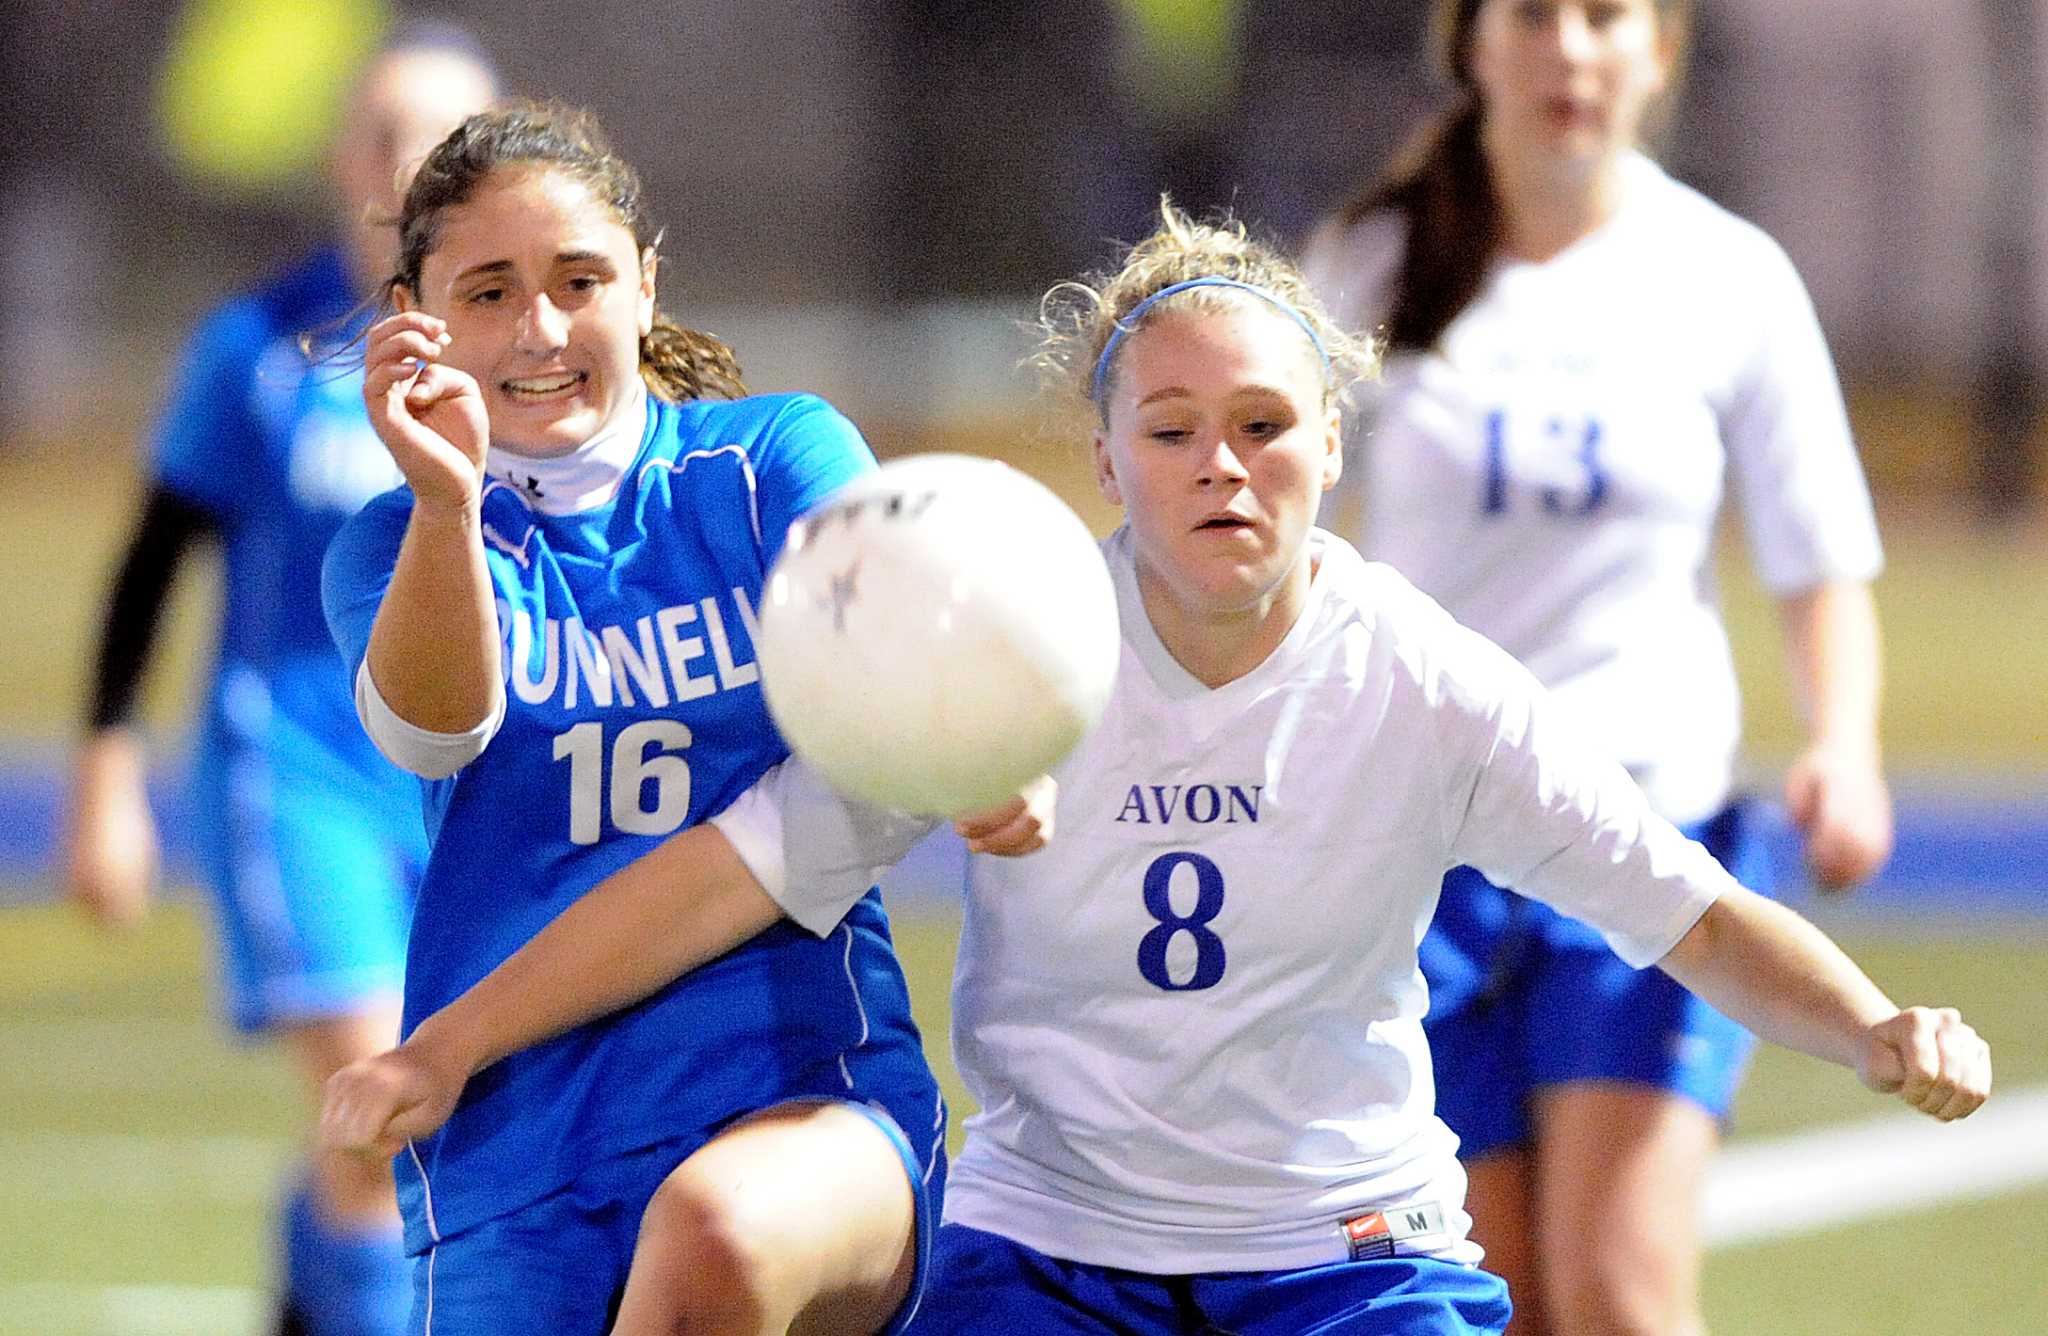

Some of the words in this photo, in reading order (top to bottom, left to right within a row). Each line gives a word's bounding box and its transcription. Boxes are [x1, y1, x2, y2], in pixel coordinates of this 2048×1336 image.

[1480, 408, 1611, 517] 13
[553, 719, 692, 846] 16
[1115, 783, 1265, 825] AVON
[1137, 851, 1226, 992] 8
[1406, 1211, 1428, 1232] M
